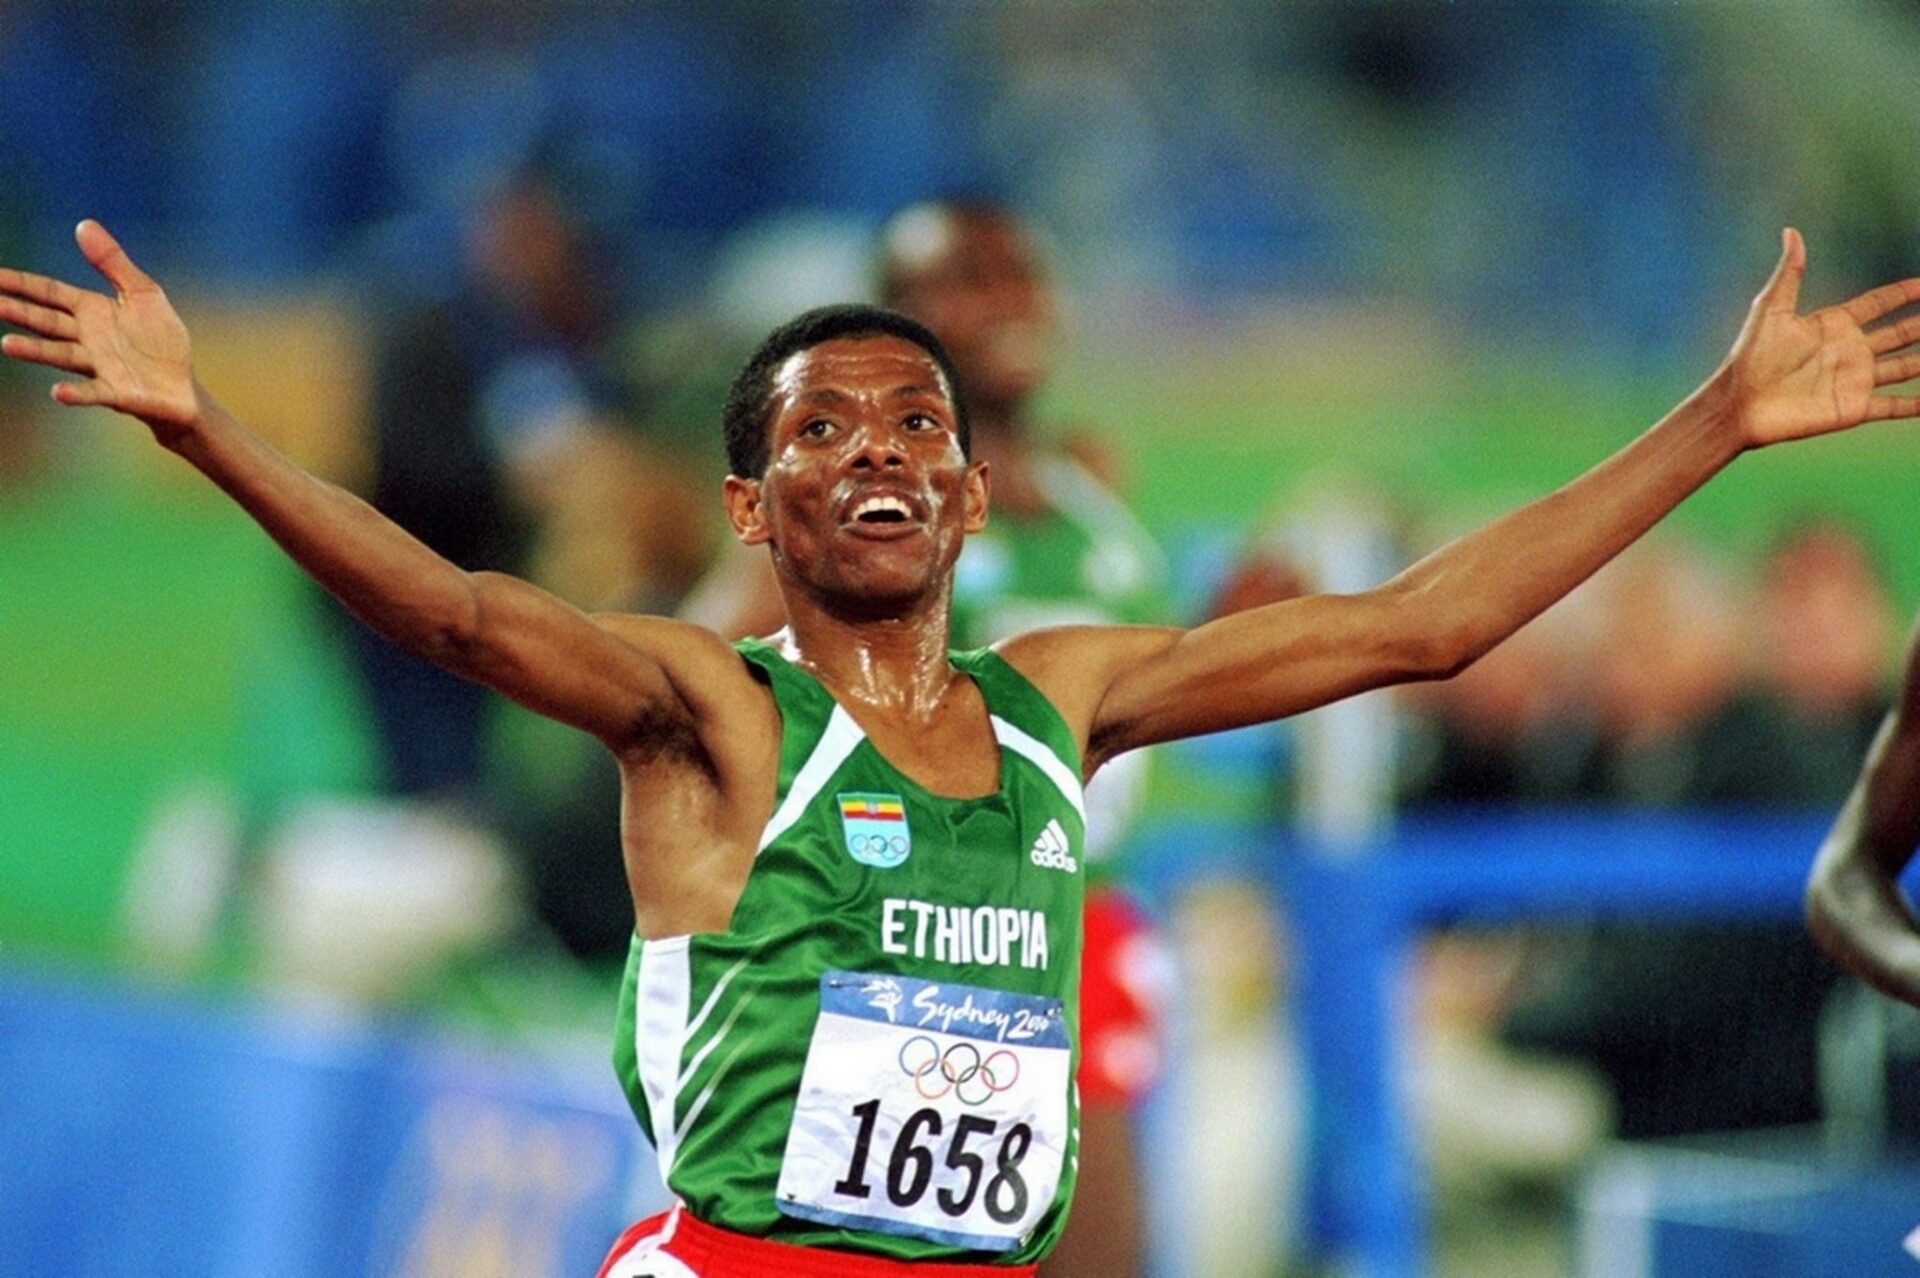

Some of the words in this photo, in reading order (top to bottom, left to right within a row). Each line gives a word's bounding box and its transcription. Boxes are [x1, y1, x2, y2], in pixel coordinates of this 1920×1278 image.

[1031, 846, 1077, 873] adidas
[881, 898, 1049, 970] ETHIOPIA
[912, 985, 1011, 1043] Sydney
[834, 1098, 1033, 1225] 1658
